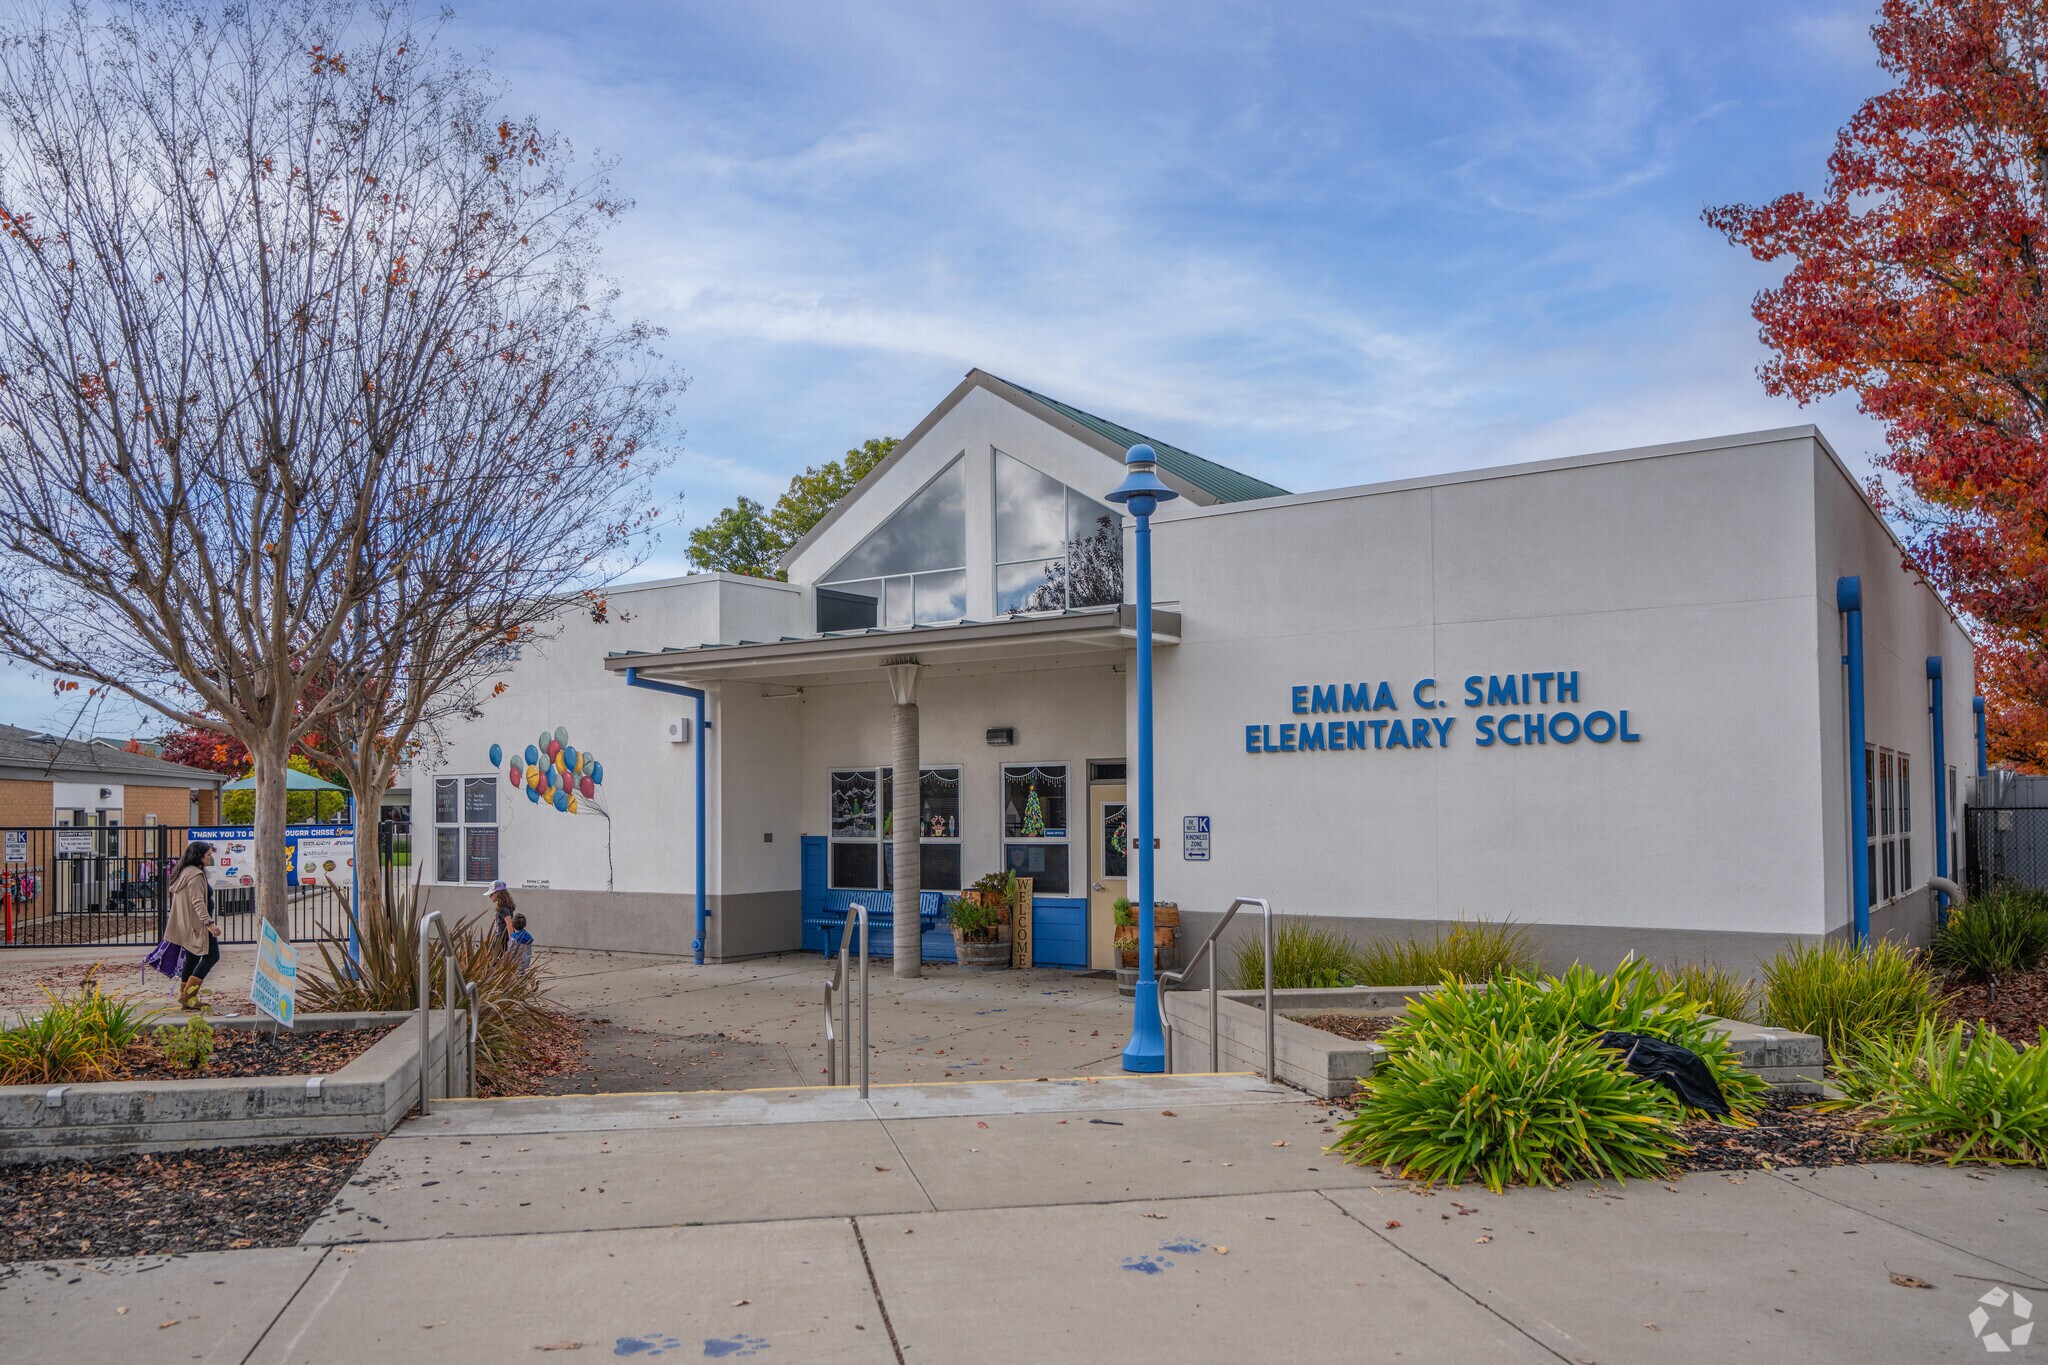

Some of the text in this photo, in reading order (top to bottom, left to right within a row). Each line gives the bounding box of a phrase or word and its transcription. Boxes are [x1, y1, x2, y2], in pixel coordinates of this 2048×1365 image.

[1291, 671, 1579, 714] EMMA C. SMITH
[1246, 709, 1641, 753] ELEMENTARY SCHOOL
[18, 832, 26, 842] K
[1199, 817, 1209, 831] K
[1016, 879, 1029, 966] WELCOME
